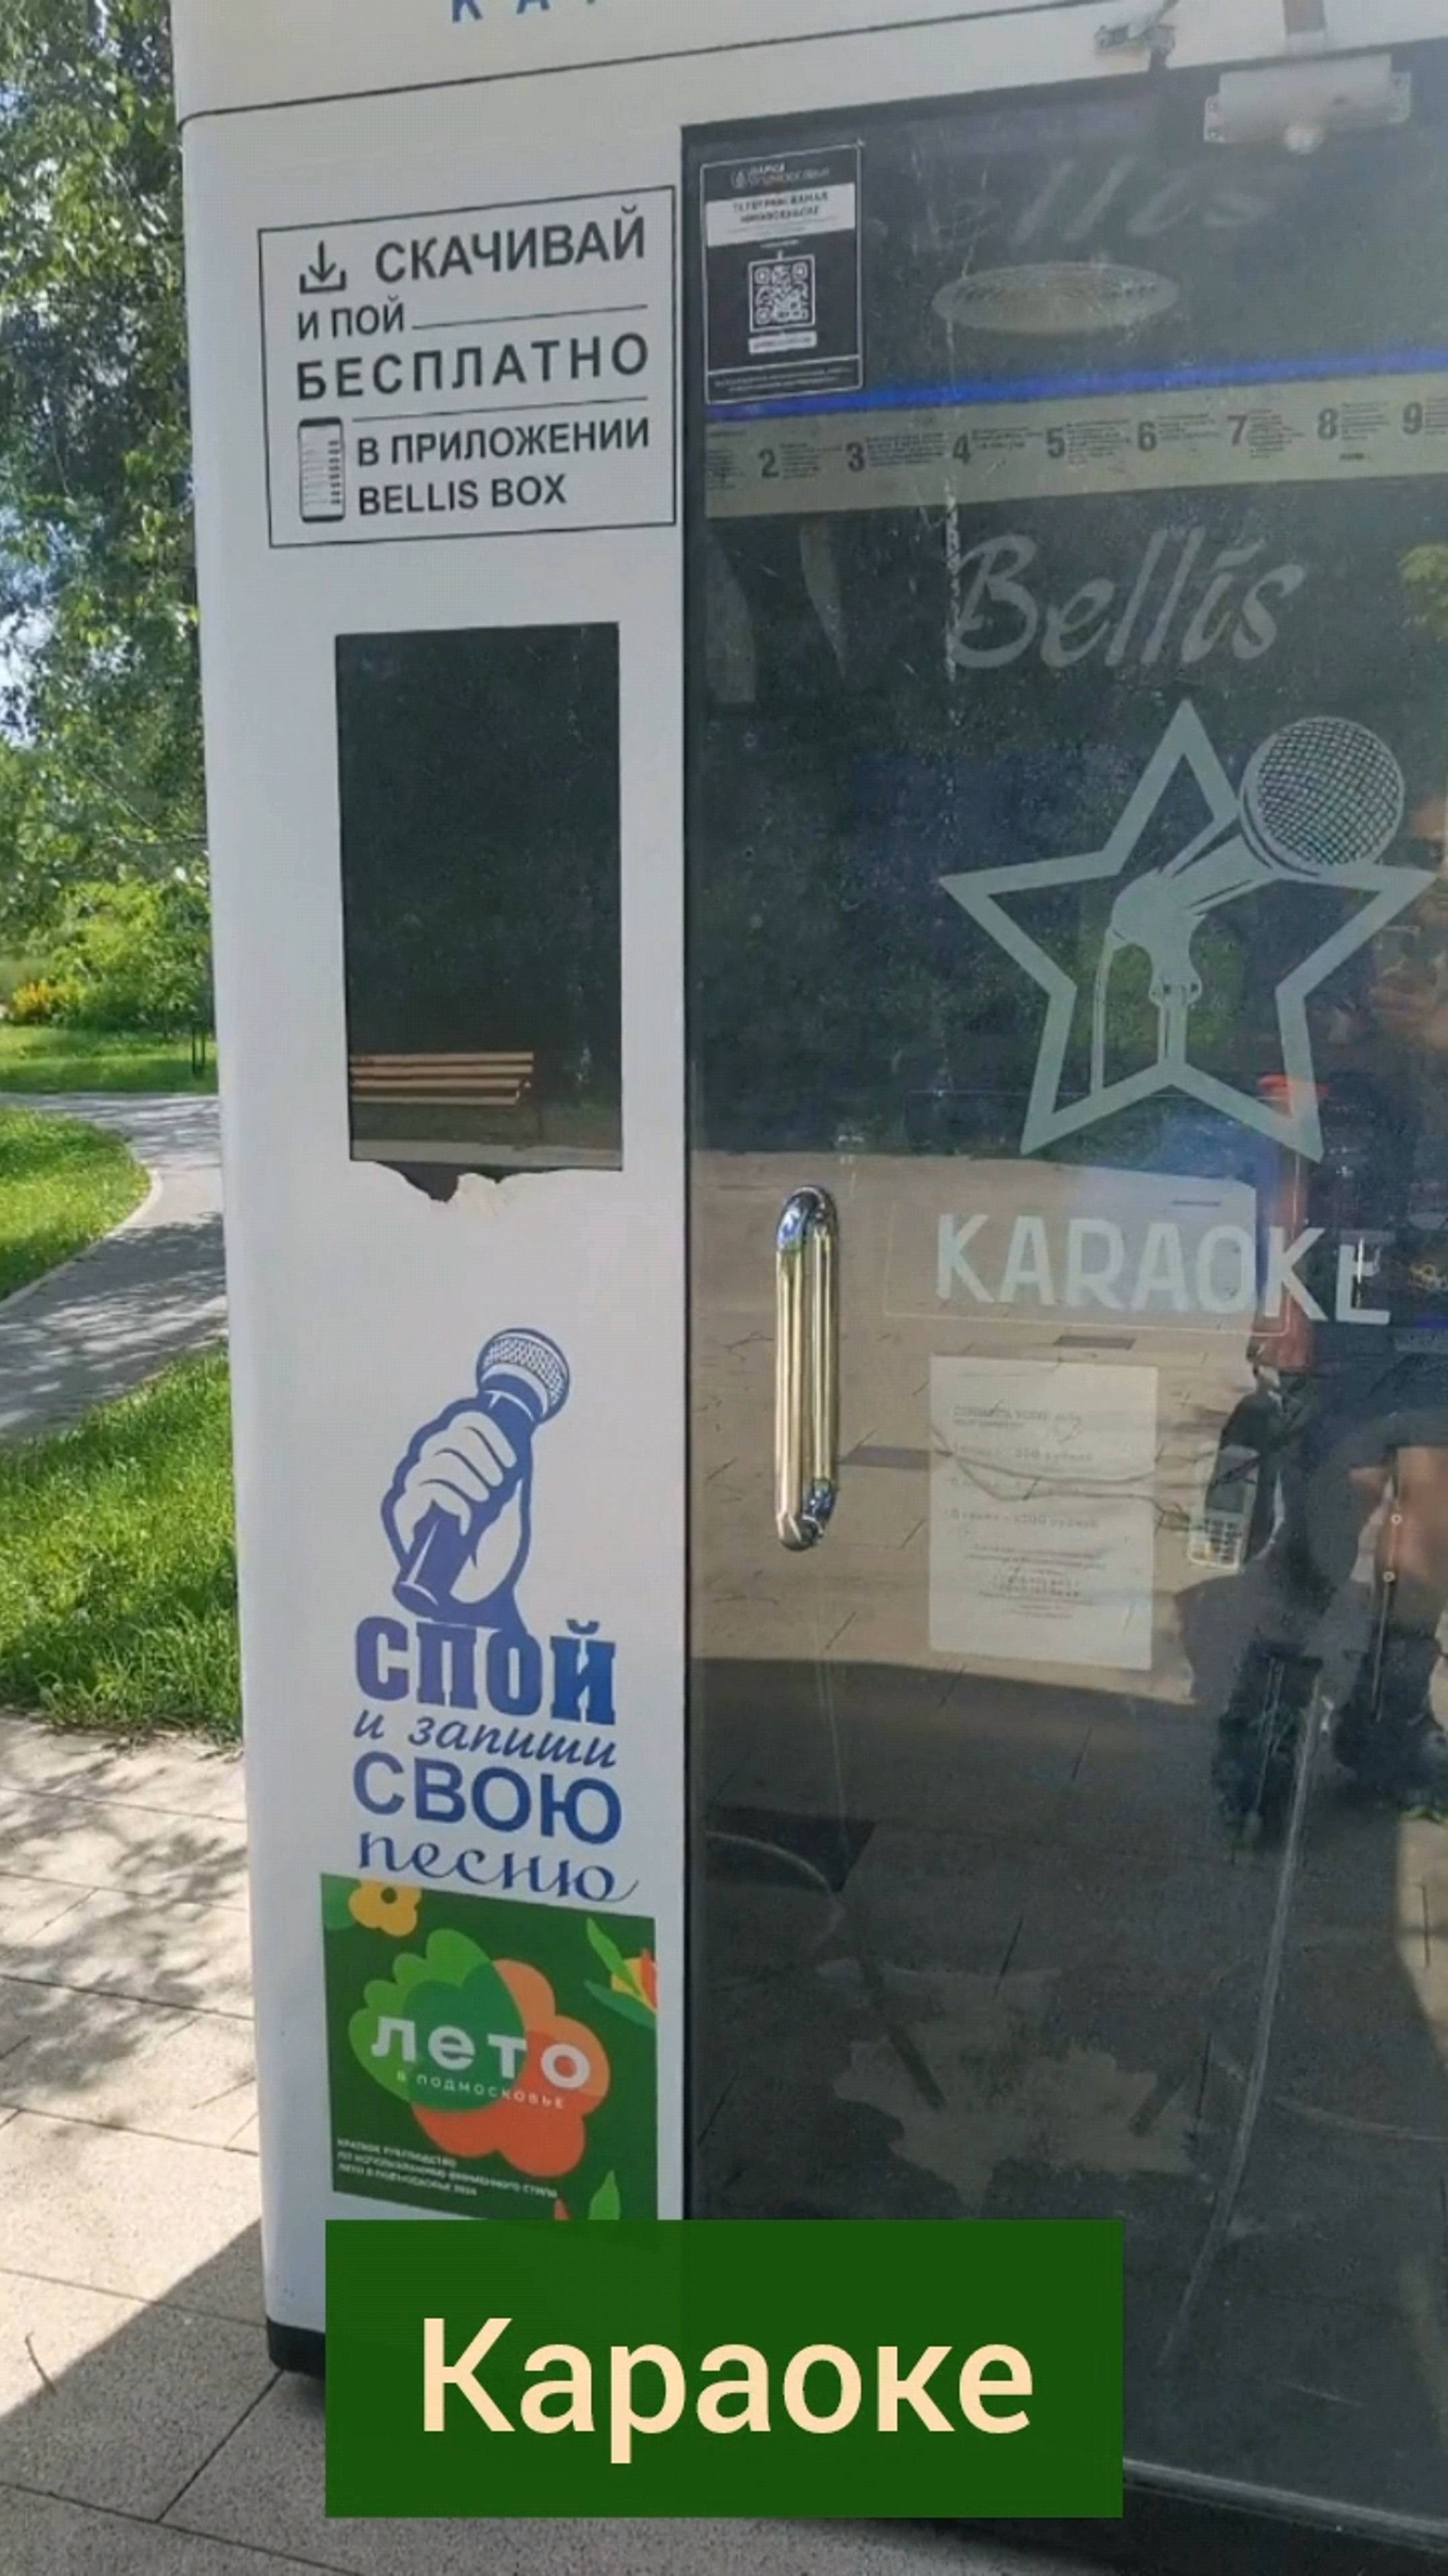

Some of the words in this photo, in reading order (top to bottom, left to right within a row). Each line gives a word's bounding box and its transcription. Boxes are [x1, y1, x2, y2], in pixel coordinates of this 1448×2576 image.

[375, 205, 645, 283] СКАЧИВАЙ
[297, 311, 319, 340] И
[331, 294, 405, 336] ПОЙ
[297, 332, 649, 400] БЕСПЛАТНО
[358, 437, 379, 466] В
[391, 417, 650, 464] ПРИЛОЖЕНИИ
[1138, 421, 1157, 452] 6
[1227, 414, 1248, 447] 7
[1317, 408, 1339, 440] 8
[1402, 402, 1423, 435] 9
[759, 448, 780, 478] 2
[845, 441, 866, 472] 3
[953, 433, 972, 465] 4
[1045, 427, 1066, 459] 5
[358, 480, 478, 515] BELLIS
[491, 474, 567, 507] BOX
[949, 526, 1306, 669] Bellis
[938, 1213, 1391, 1326] KARAOKE
[356, 1616, 616, 1725] СПОЙ
[354, 1709, 384, 1740] и
[408, 1717, 617, 1768] запиши
[353, 1750, 622, 1845] СВОЮ
[359, 1831, 639, 1902] песню
[371, 2015, 590, 2089] лето
